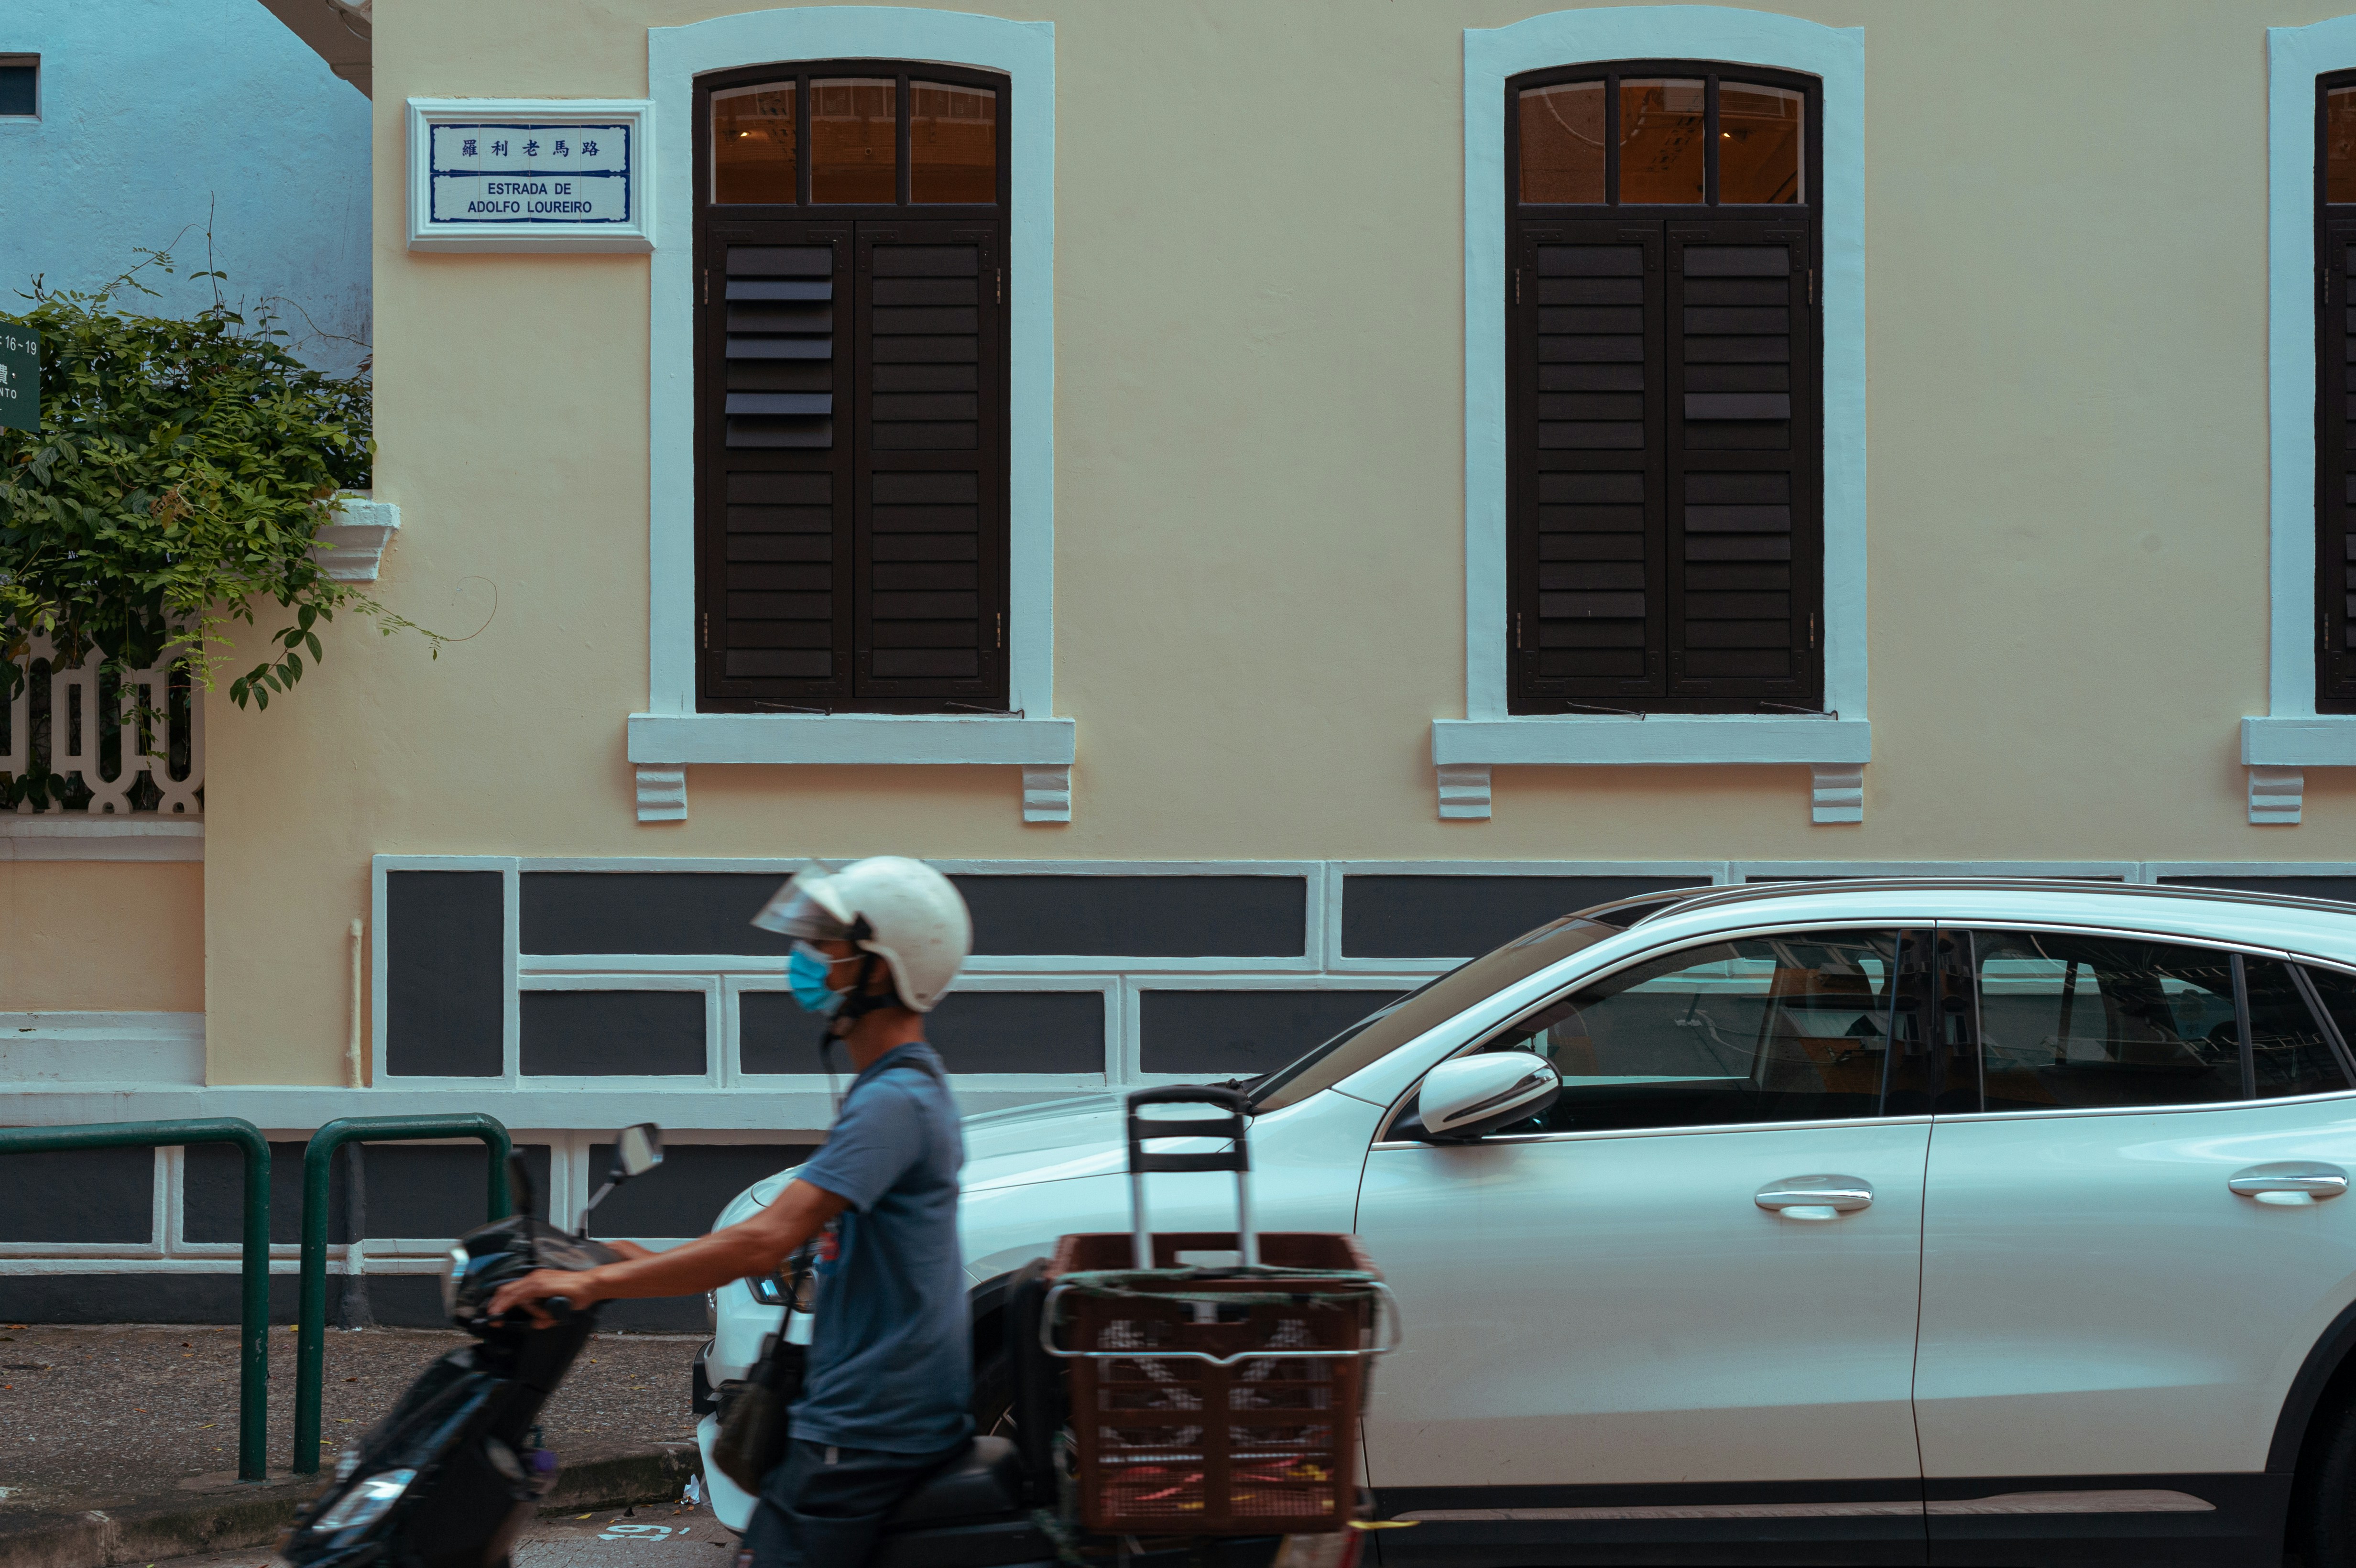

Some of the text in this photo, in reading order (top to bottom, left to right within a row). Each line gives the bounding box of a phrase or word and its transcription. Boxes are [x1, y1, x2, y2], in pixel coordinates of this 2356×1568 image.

[462, 139, 600, 157] 羅利老馬路
[488, 183, 571, 195] ESTRADA DE
[468, 201, 592, 213] ADOLFO LOUREIRO
